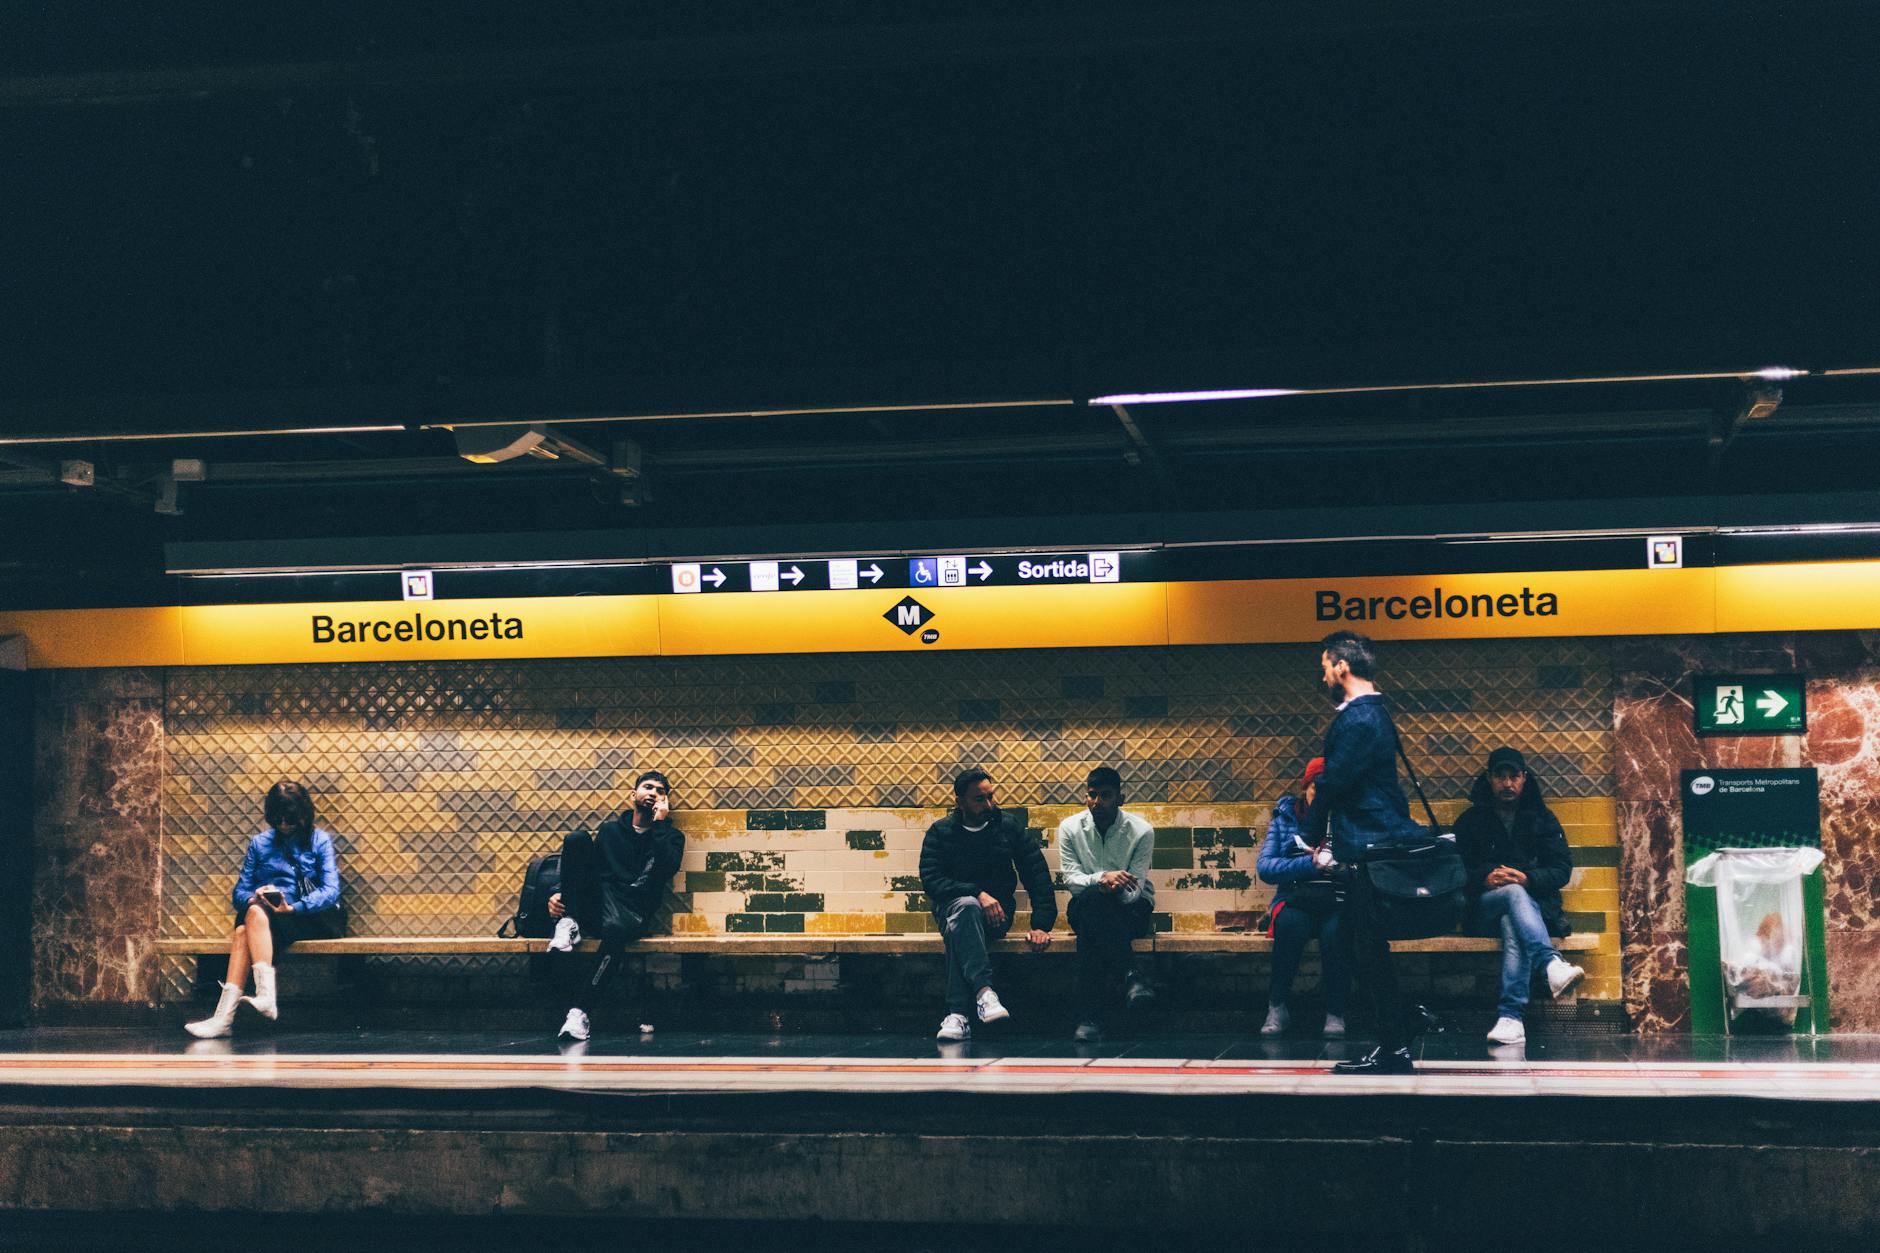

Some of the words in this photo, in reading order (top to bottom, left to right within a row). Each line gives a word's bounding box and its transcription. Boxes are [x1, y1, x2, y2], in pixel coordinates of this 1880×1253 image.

[1018, 560, 1089, 579] Sortida
[1315, 587, 1558, 621] Barceloneta
[898, 605, 920, 625] M
[312, 613, 523, 643] Barceloneta
[1719, 779, 1754, 787] Transports
[1755, 778, 1800, 787] Metropolitans
